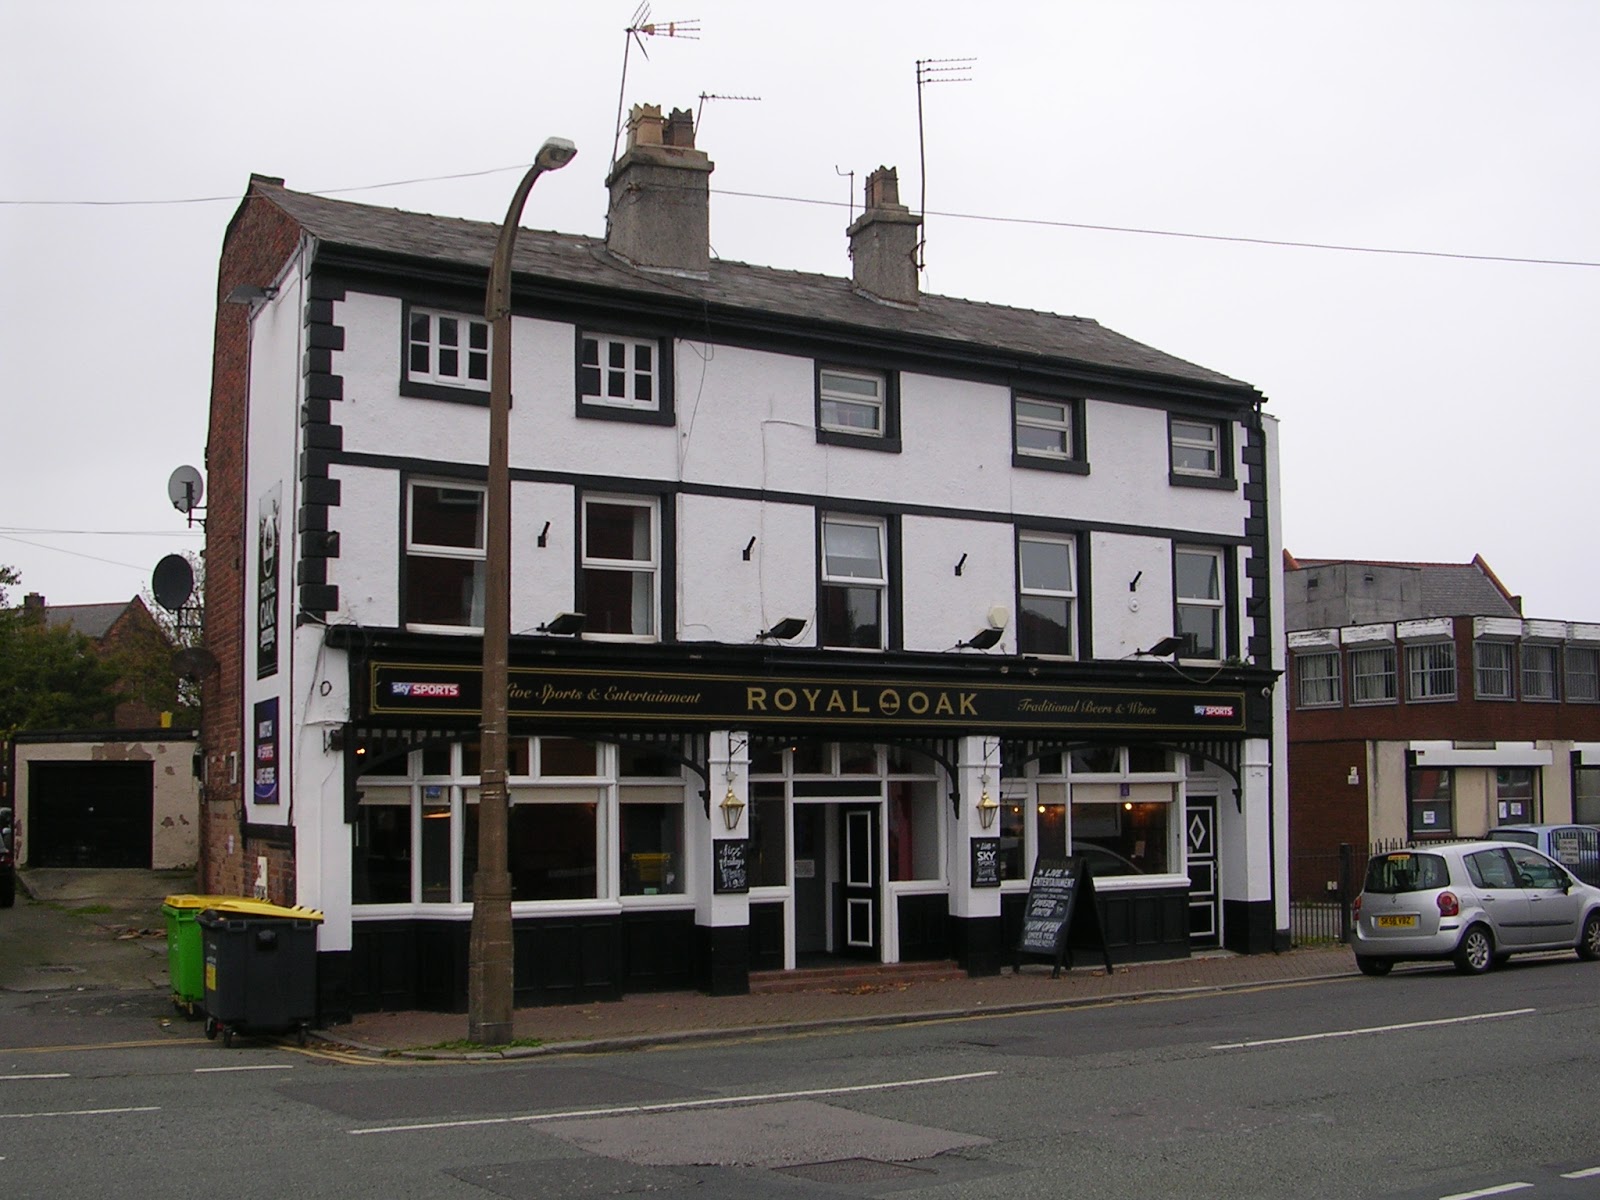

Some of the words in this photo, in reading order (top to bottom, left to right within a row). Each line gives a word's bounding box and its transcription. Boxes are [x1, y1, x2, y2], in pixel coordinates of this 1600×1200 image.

[261, 597, 275, 629] OAK
[392, 682, 410, 696] sky
[412, 683, 459, 696] SPORTS
[536, 684, 583, 705] Sports
[587, 688, 600, 701] &
[604, 685, 701, 703] Entertainment
[746, 687, 870, 713] ROYAL
[908, 691, 978, 716] OAK
[1018, 698, 1080, 713] Traditional
[1081, 700, 1112, 714] Beers
[1115, 704, 1125, 714] &
[1127, 702, 1157, 715] Wines
[1206, 706, 1233, 716] SPORTS
[977, 851, 996, 861] SKY
[1045, 869, 1063, 877] LIVE
[1033, 877, 1076, 888] ENTERTAINMENT
